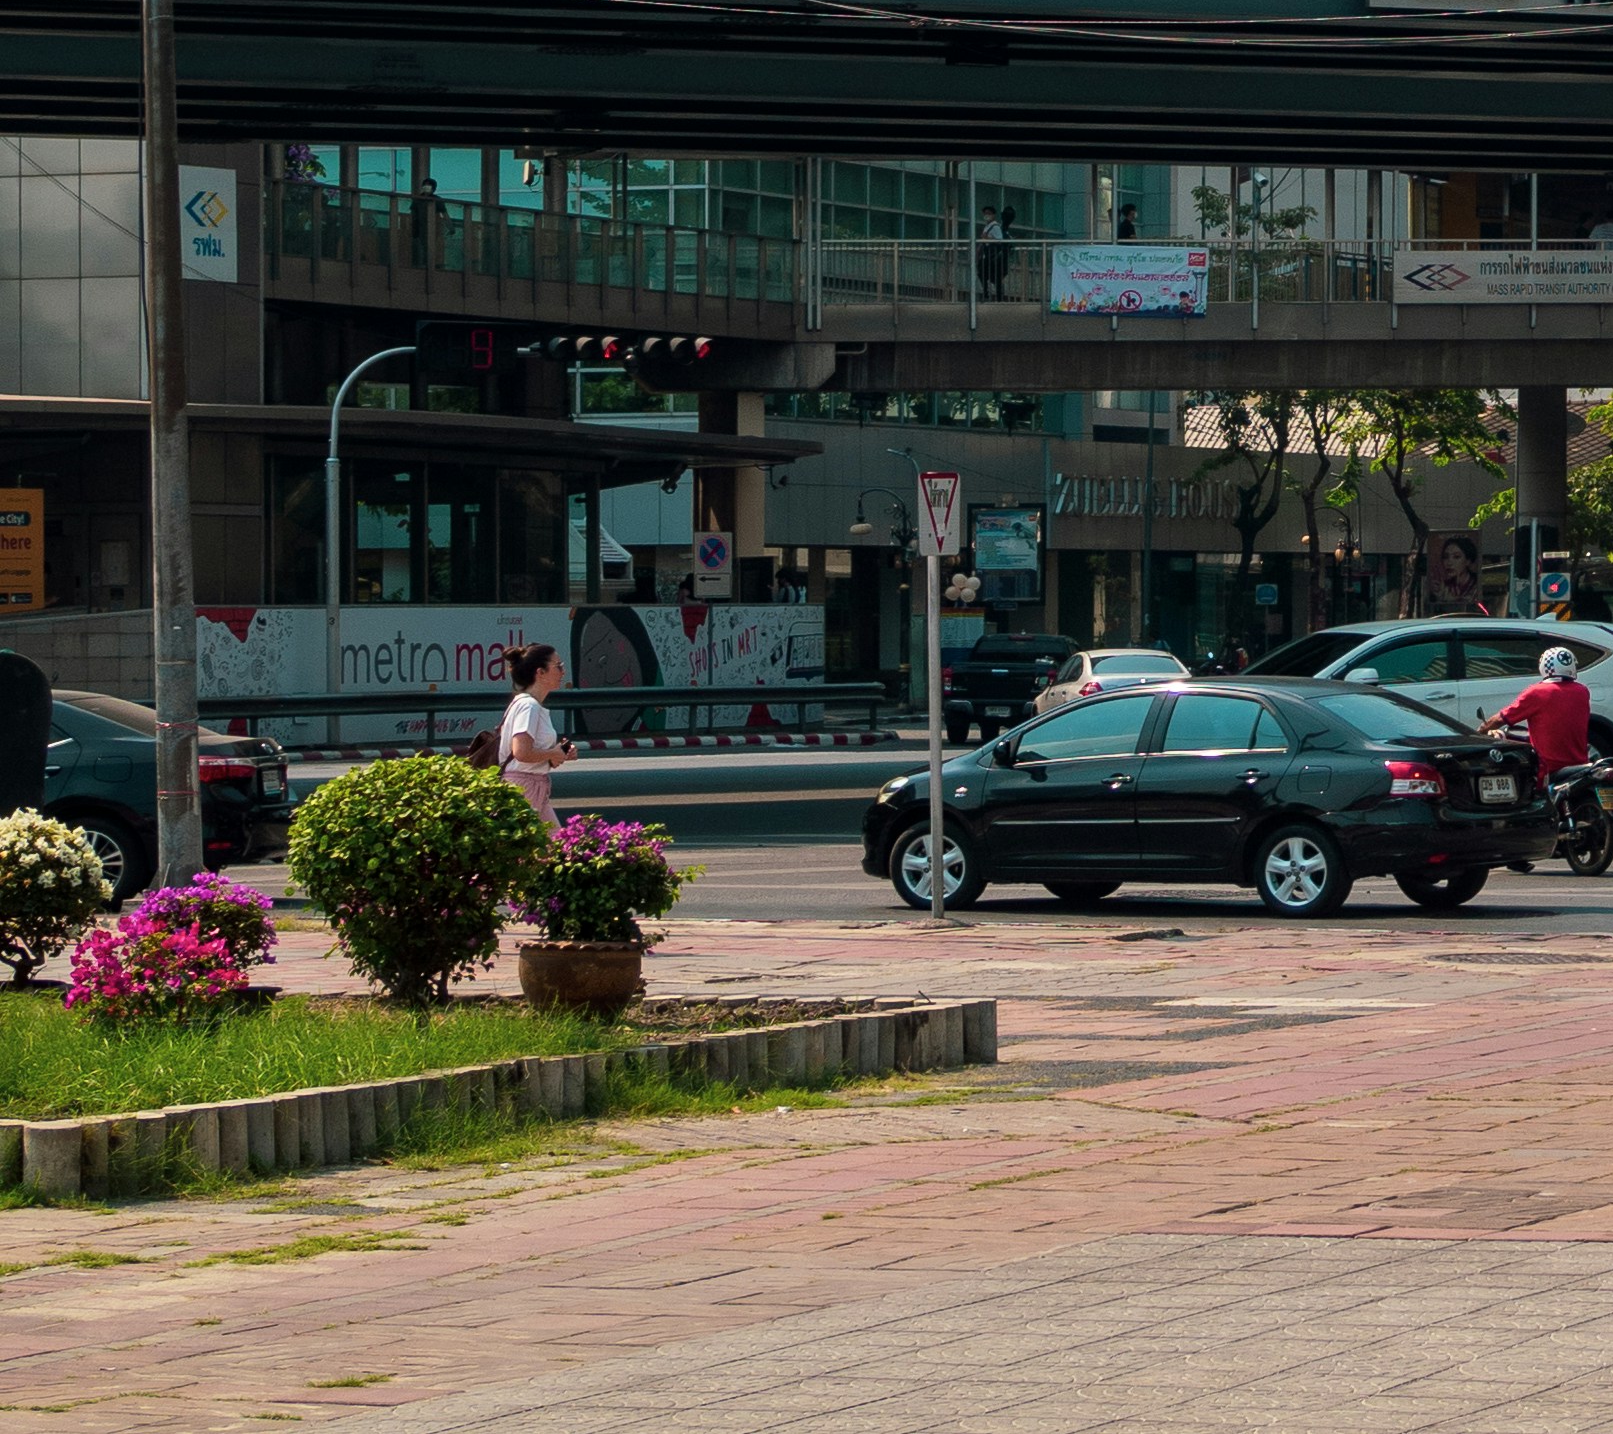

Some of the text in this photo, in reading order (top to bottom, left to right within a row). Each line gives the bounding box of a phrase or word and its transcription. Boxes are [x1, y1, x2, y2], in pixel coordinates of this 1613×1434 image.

[1487, 283, 1509, 295] MASS
[1510, 283, 1533, 295] RAPID
[1535, 283, 1567, 295] TRANSIT
[1568, 283, 1610, 295] AUTHORITY
[471, 328, 493, 369] 9
[341, 630, 449, 685] metro
[722, 635, 734, 665] IN
[737, 625, 758, 659] MRT
